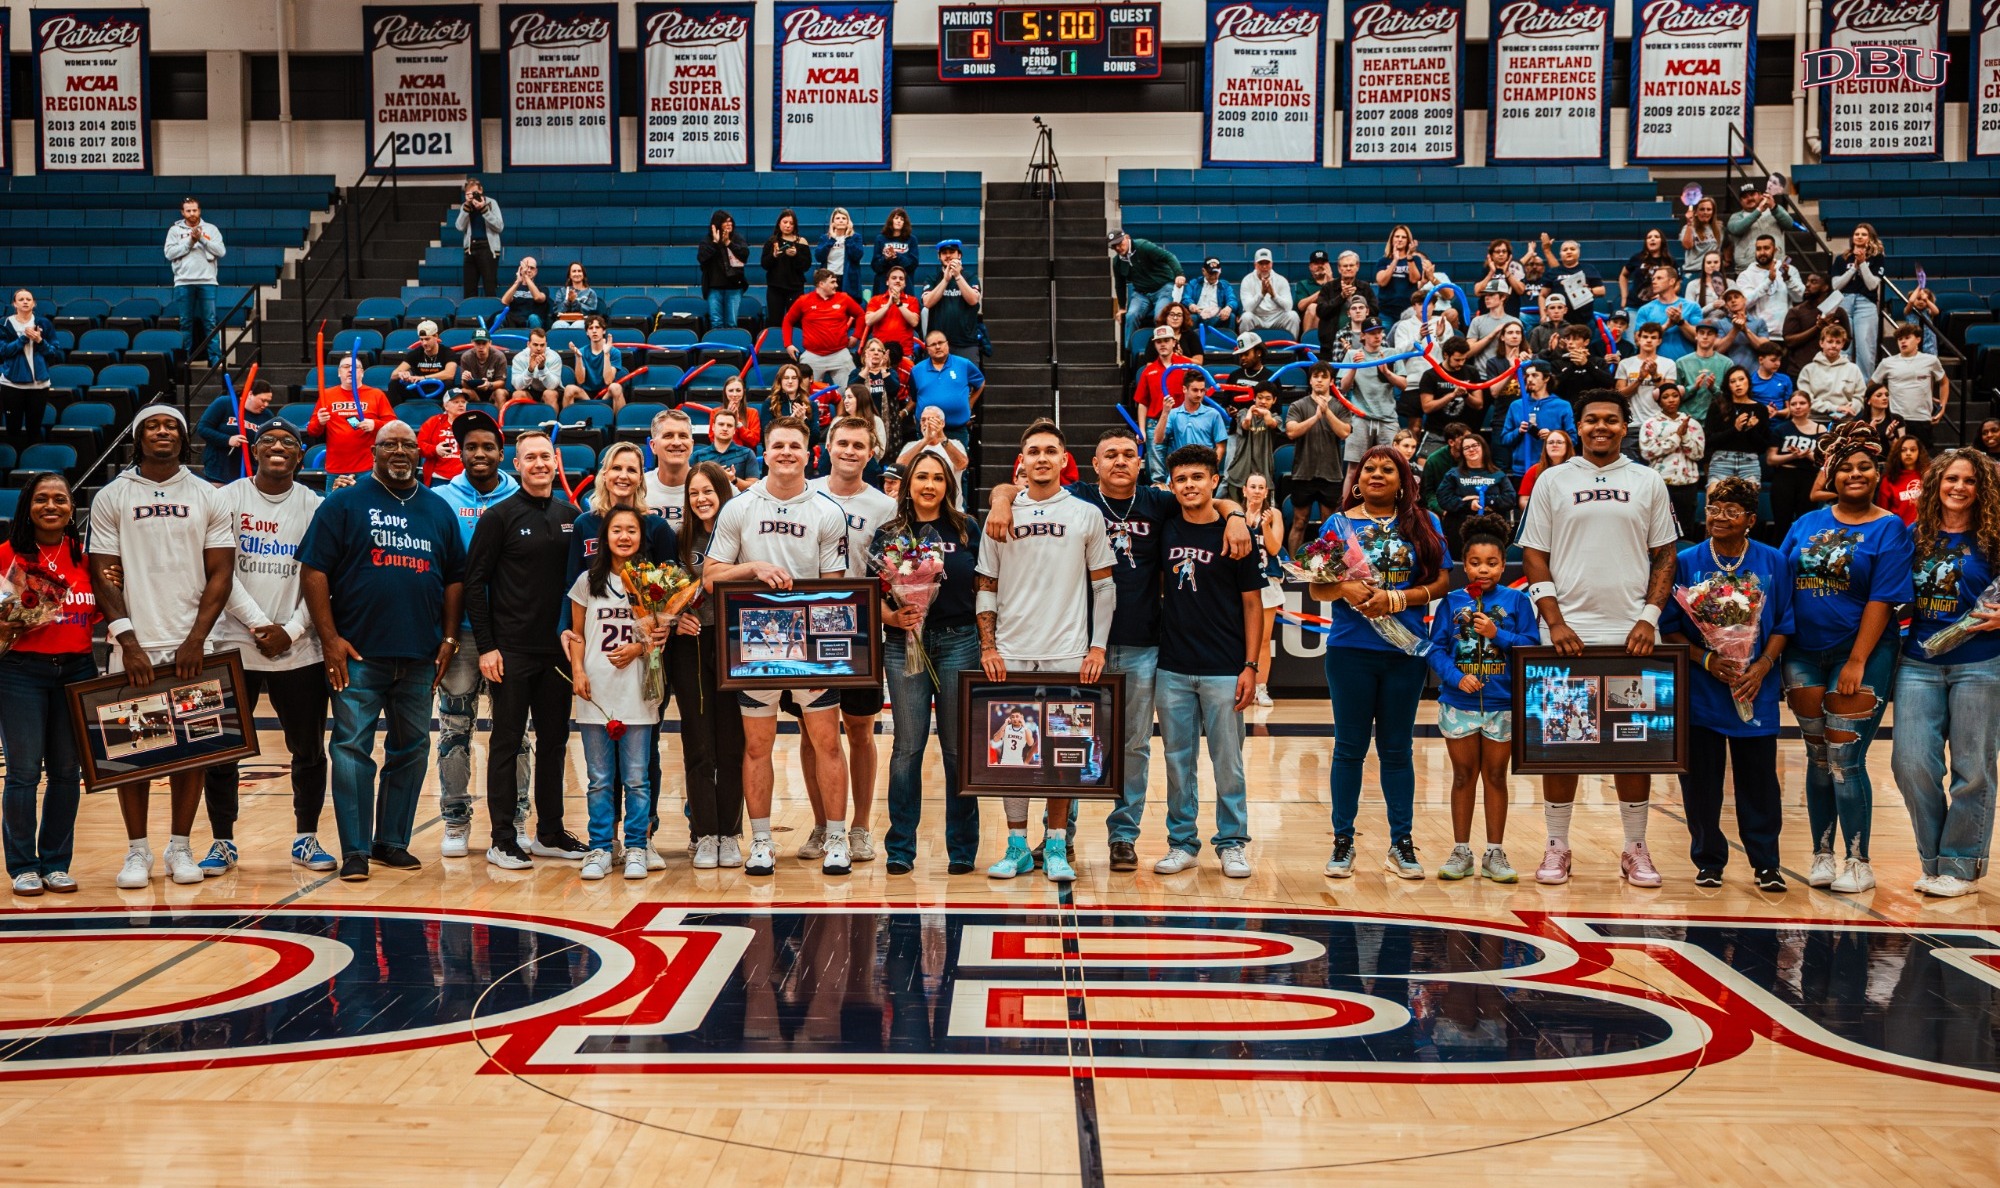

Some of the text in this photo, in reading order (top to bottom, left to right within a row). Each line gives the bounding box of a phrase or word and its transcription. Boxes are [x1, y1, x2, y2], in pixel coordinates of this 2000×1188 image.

[943, 11, 993, 25] PATRIOTS
[1110, 9, 1152, 23] GUEST
[1353, 3, 1458, 40] Patriots
[1500, 2, 1605, 38] Patriots
[1642, 0, 1748, 37] Patriots
[1832, 0, 1939, 32] Patriots
[646, 11, 748, 47] Patriots
[783, 9, 885, 45] Patriots
[1022, 11, 1096, 41] 5:00
[1215, 5, 1318, 42] Patriots
[40, 15, 140, 52] Patriots
[373, 15, 471, 50] Patriots
[510, 13, 609, 49] Patriots
[973, 29, 989, 58] 0
[1135, 27, 1152, 56] 0
[1030, 47, 1049, 55] POSS
[1022, 56, 1057, 66] PERIOD
[1071, 51, 1076, 74] 1
[1103, 61, 1136, 72] BONUS
[1364, 58, 1445, 71] HEARTLAND
[1510, 57, 1591, 69] HEARTLAND
[1665, 59, 1720, 76] NCAA
[521, 66, 599, 78] HEARTLAND
[675, 65, 716, 77] NCAA
[806, 68, 859, 84] NCAA
[963, 64, 996, 74] BONUS
[66, 76, 118, 91] NCAA
[399, 74, 445, 89] NCAA
[1227, 79, 1303, 91] NATIONAL
[1359, 72, 1450, 86] CONFERENCE
[1505, 72, 1596, 84] CONFERENCE
[516, 81, 603, 94] CONFERENCE
[669, 81, 722, 95] SUPER
[1504, 87, 1596, 101] CHAMPIONS
[1644, 81, 1741, 96] NATIONALS
[385, 92, 460, 106] NATIONAL
[786, 89, 878, 103] NATIONALS
[1219, 93, 1310, 107] CHAMPIONS
[1358, 88, 1451, 103] CHAMPIONS
[46, 96, 137, 111] REGIONALS
[516, 96, 605, 110] CHAMPIONS
[651, 97, 740, 111] REGIONALS
[1835, 103, 1932, 114] 2011 2012 2014
[379, 108, 467, 123] CHAMPIONS
[787, 113, 813, 123] 2016
[1218, 111, 1308, 121] 2009 2010 2011
[1356, 108, 1453, 120] 2007 2008 2009
[1503, 107, 1595, 118] 2016 2017 2018
[1644, 106, 1740, 116] 2009 2015 2022
[48, 121, 136, 131] 2013 2014 2015
[516, 116, 605, 126] 2013 2015 2016
[649, 115, 739, 125] 2009 2010 2013
[1835, 120, 1931, 131] 2015 2016 2017
[1218, 127, 1244, 137] 2018
[1356, 125, 1452, 136] 2010 2011 2012
[1643, 123, 1671, 133] 2023
[49, 137, 136, 147] 2016 2017 2018
[649, 132, 739, 141] 2014 2015 2016
[1835, 136, 1932, 148] 2018 2019 2021
[395, 133, 452, 155] 2021
[1356, 142, 1452, 153] 2013 2014 2015
[51, 153, 139, 164] 2019 2021 2022
[649, 148, 674, 158] 2017
[1573, 489, 1631, 505] DBU
[133, 504, 190, 521] DBU
[368, 508, 408, 529] Love
[240, 513, 279, 534] Love
[759, 519, 806, 538] DBU
[1013, 522, 1066, 540] DBU
[371, 529, 432, 553] Wisdom
[1169, 547, 1214, 564] DBU
[1796, 577, 1824, 590] SENIOR
[66, 588, 96, 606] dom
[1930, 598, 1959, 612] NIGHT
[601, 624, 633, 652] 25
[1481, 663, 1507, 675] NIGHT
